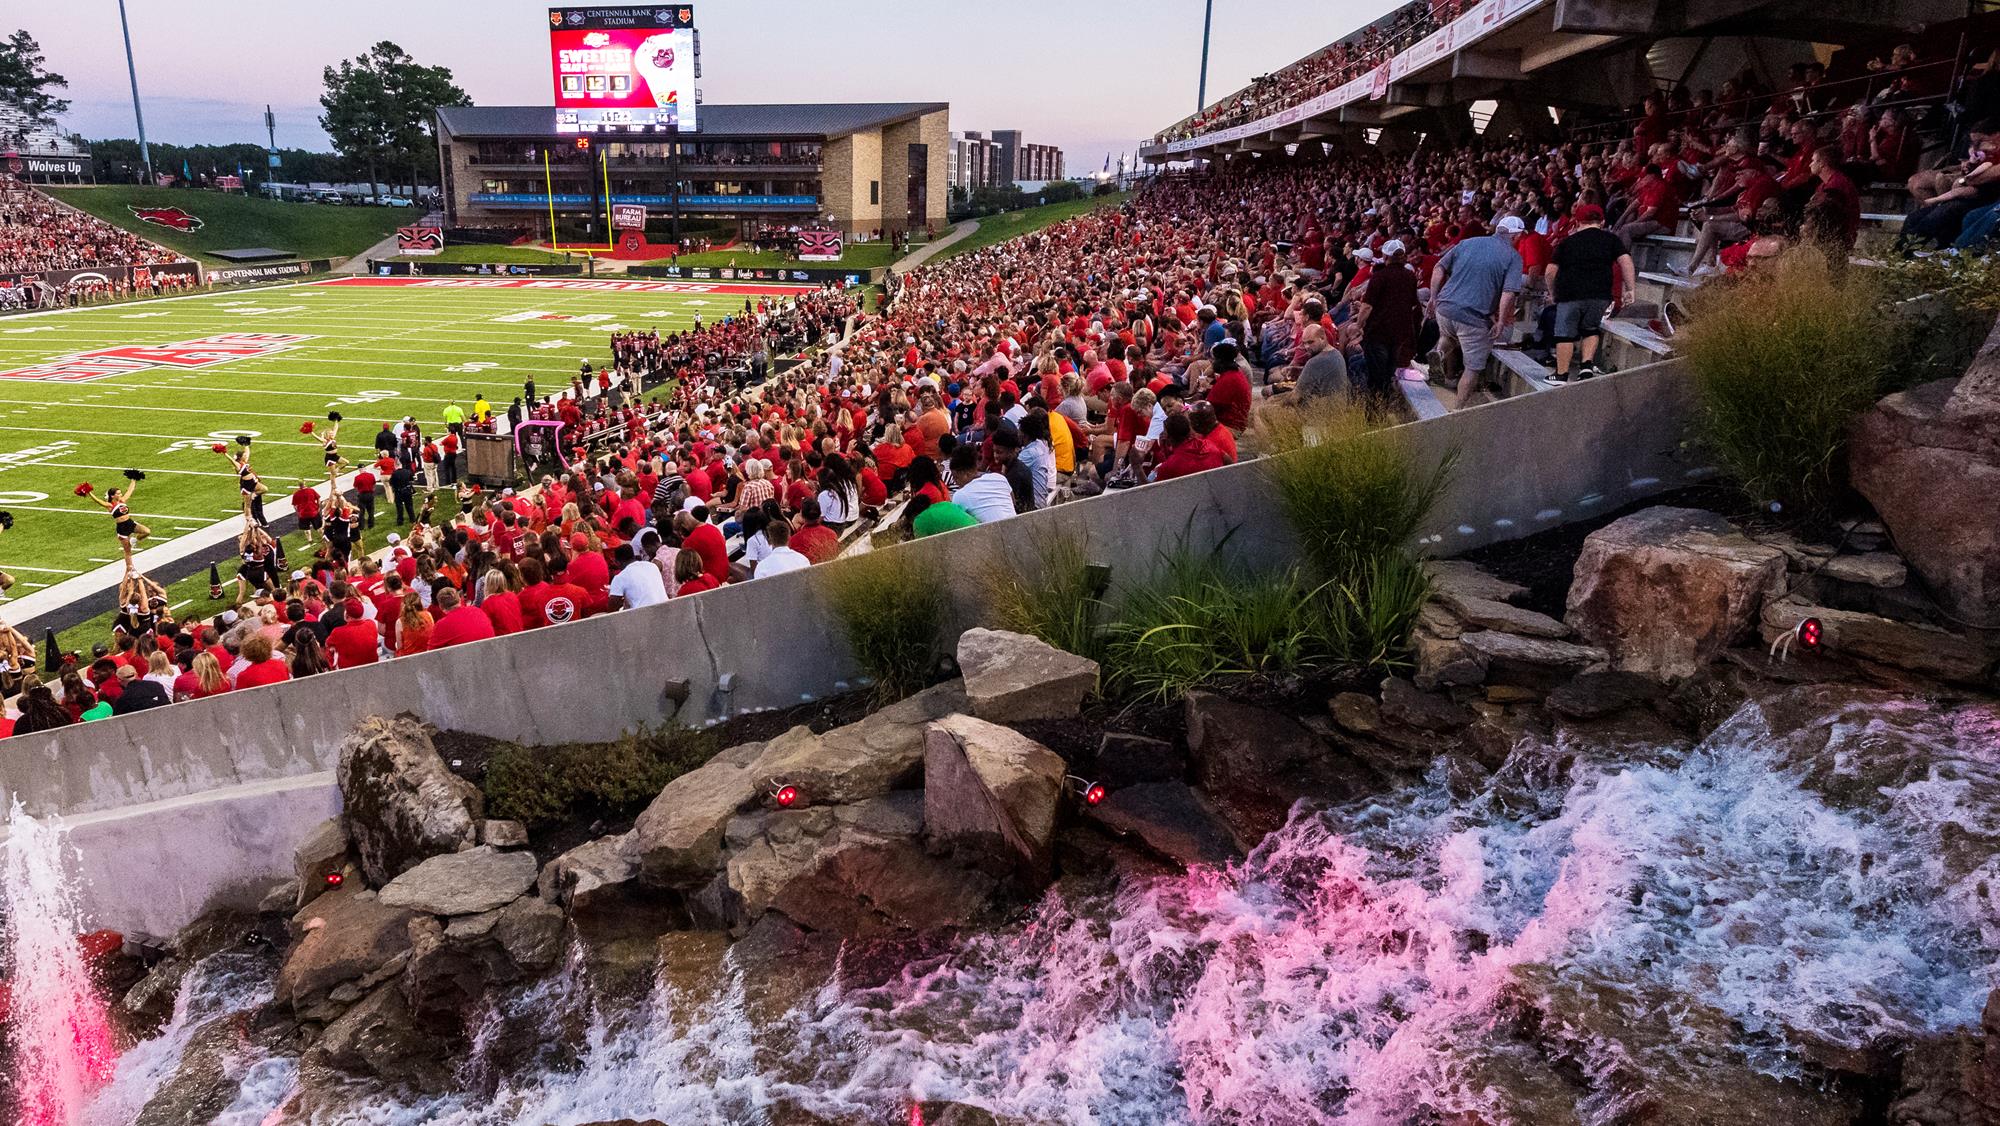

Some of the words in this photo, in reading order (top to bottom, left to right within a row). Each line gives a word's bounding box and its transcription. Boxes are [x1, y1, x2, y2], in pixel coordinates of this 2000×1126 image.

[587, 9, 631, 18] CENTENNIAL
[632, 9, 652, 17] BANK
[603, 17, 635, 25] STADIUM
[559, 48, 632, 63] SWEETEST
[588, 77, 604, 90] 12
[577, 138, 589, 148] 25
[28, 160, 66, 172] Wolves
[68, 161, 82, 175] Up
[615, 214, 642, 222] BUREAU
[222, 268, 263, 279] CENTENNIAL
[263, 267, 278, 276] BANK
[278, 265, 300, 274] STADIUM
[406, 279, 519, 287] RED
[519, 281, 720, 293] WOLVES
[0, 332, 323, 383] STATE
[441, 361, 500, 373] 50
[336, 389, 401, 403] 40
[170, 429, 262, 450] 30
